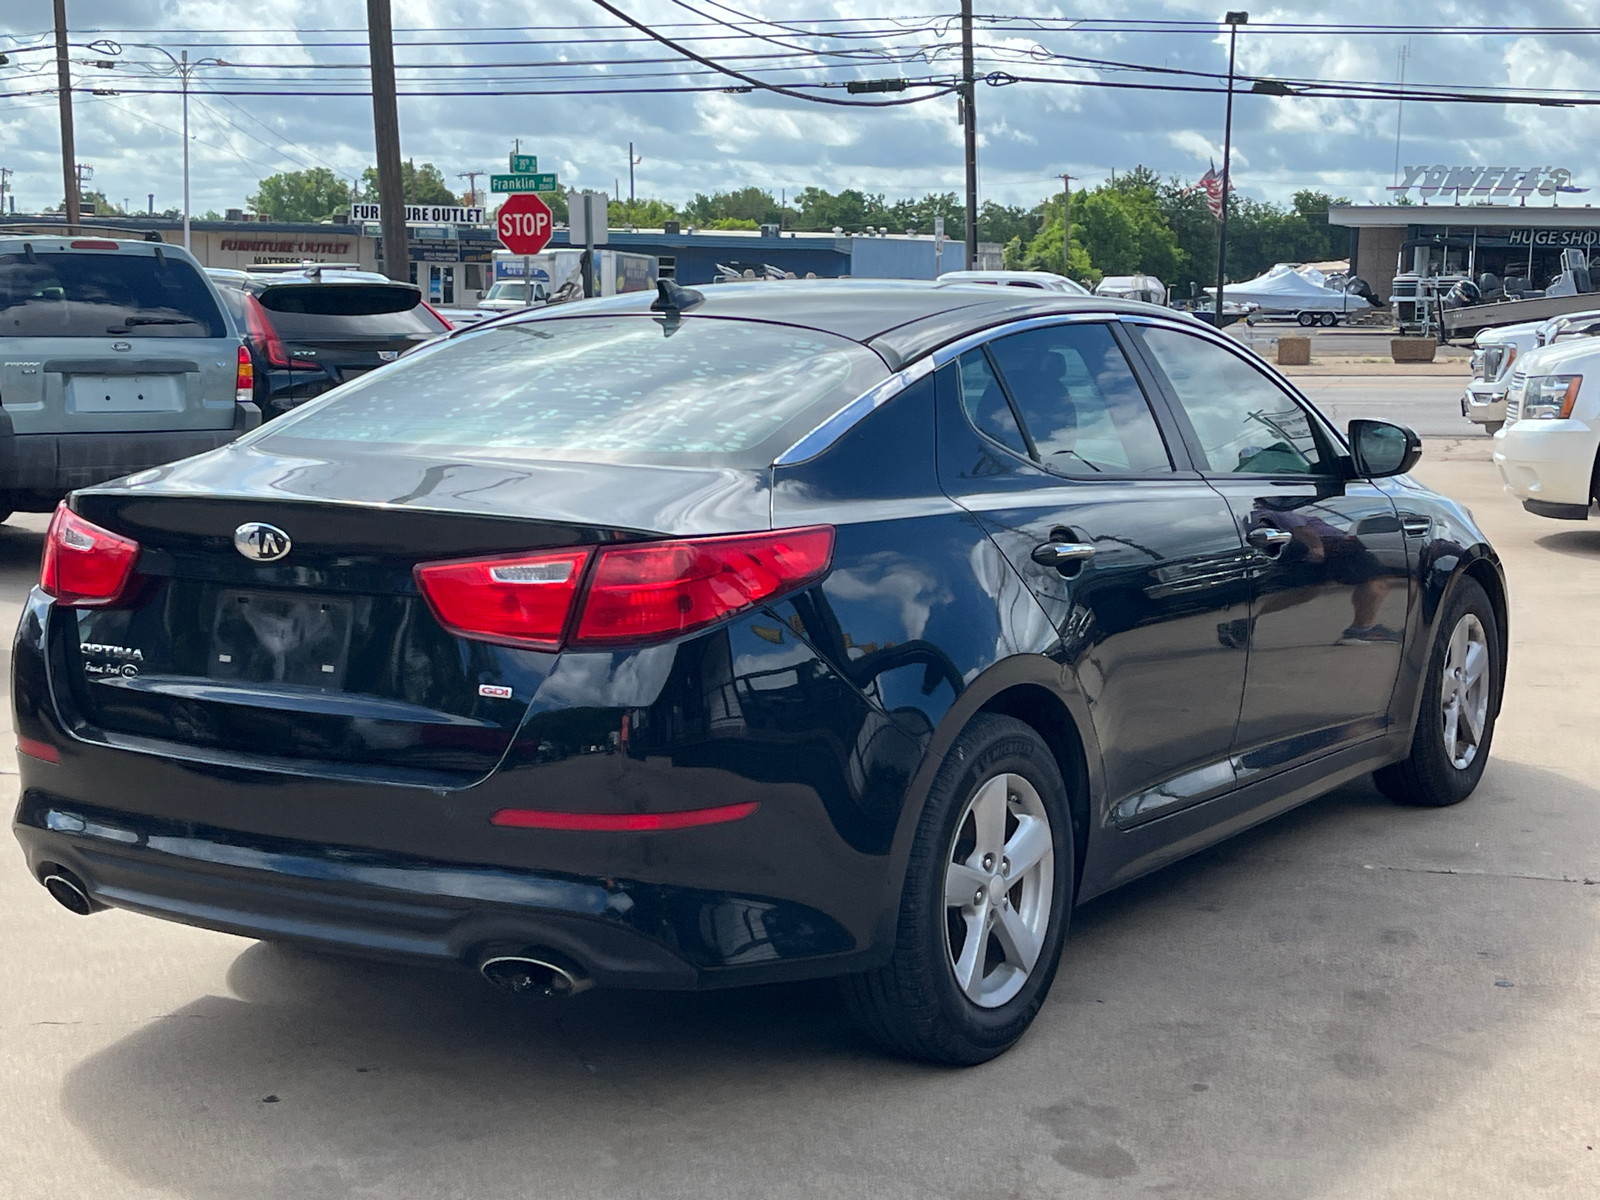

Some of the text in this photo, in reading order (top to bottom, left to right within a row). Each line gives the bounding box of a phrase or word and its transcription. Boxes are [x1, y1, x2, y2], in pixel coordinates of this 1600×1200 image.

[492, 177, 536, 190] Franklin
[1395, 165, 1571, 197] YOWELL'S
[353, 204, 482, 222] FURURE OUTLET
[501, 212, 548, 237] STOP
[220, 240, 351, 254] FURNITURE OUTLET
[1509, 230, 1600, 247] HUGE SHO
[80, 642, 144, 661] OPTIMA
[481, 686, 509, 697] GDI
